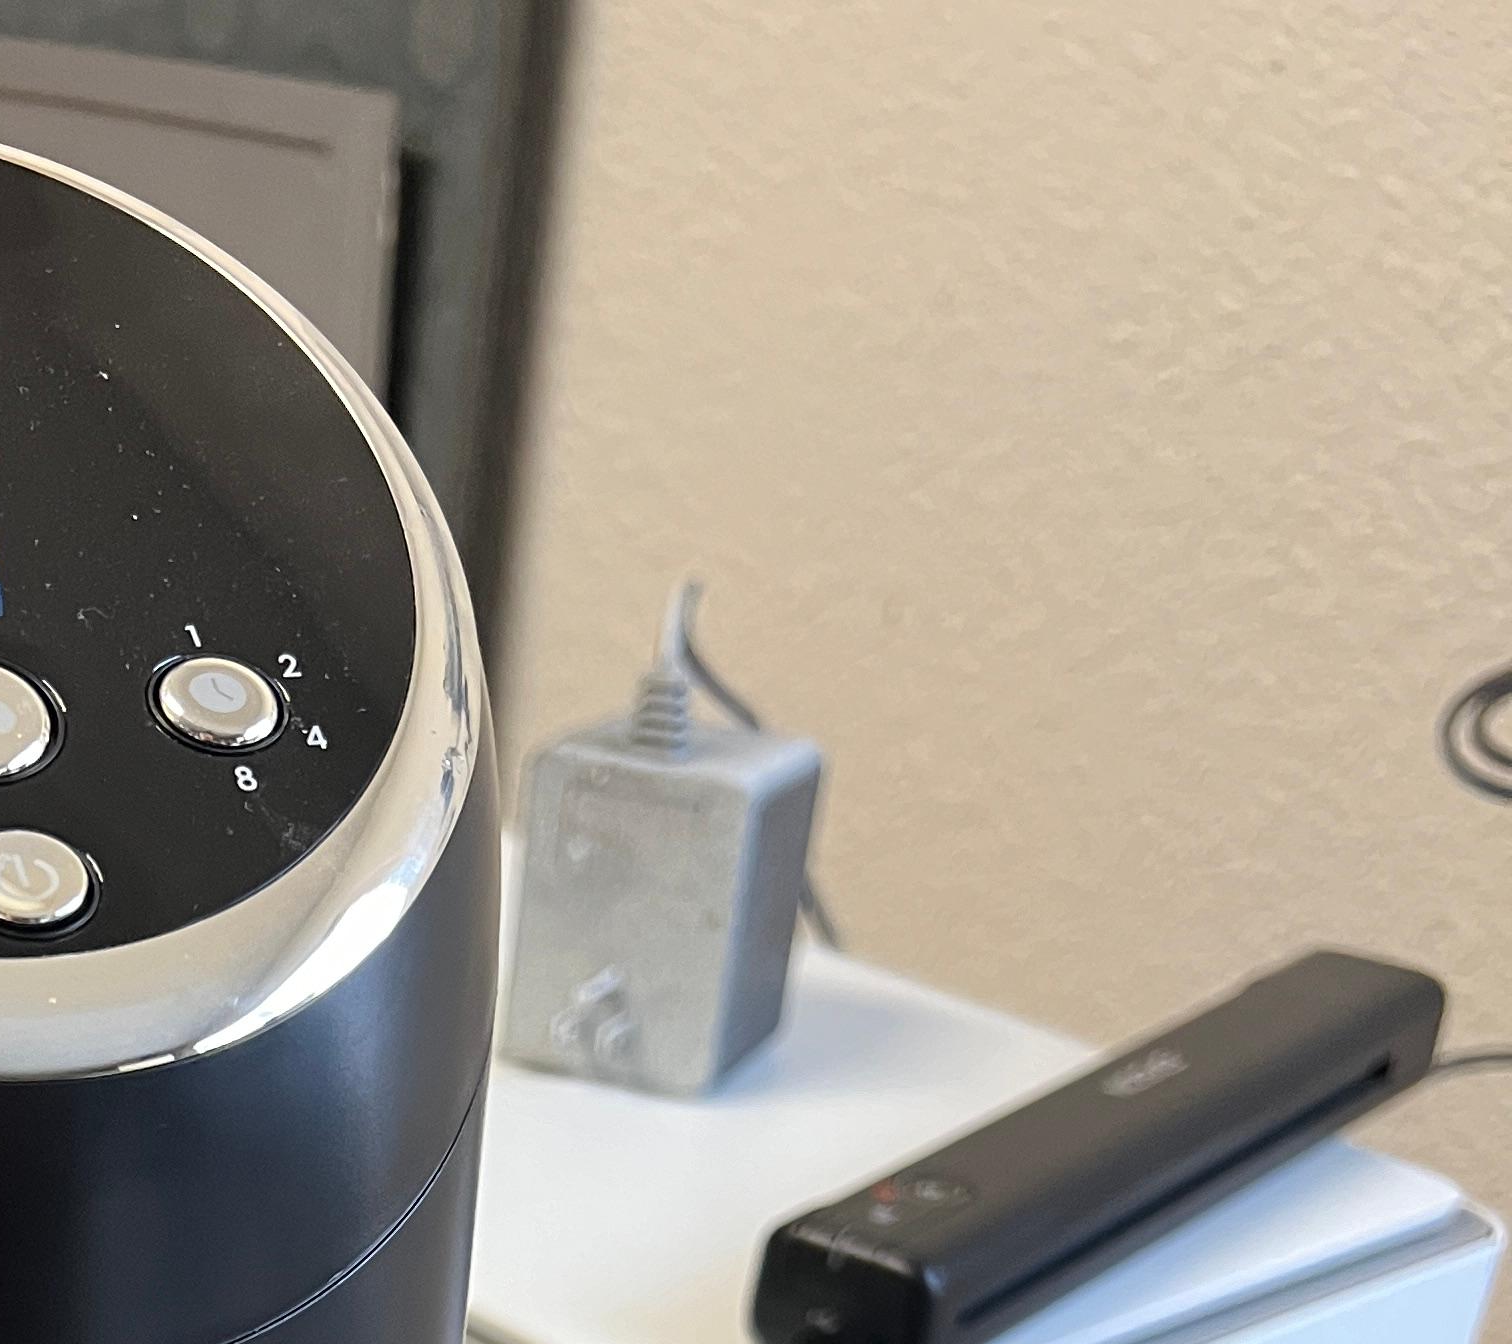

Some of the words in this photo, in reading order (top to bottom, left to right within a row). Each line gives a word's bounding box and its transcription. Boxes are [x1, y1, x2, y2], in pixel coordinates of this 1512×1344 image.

[184, 624, 202, 648] 1
[277, 653, 303, 678] 2
[304, 724, 329, 750] 4
[234, 765, 258, 792] 8
